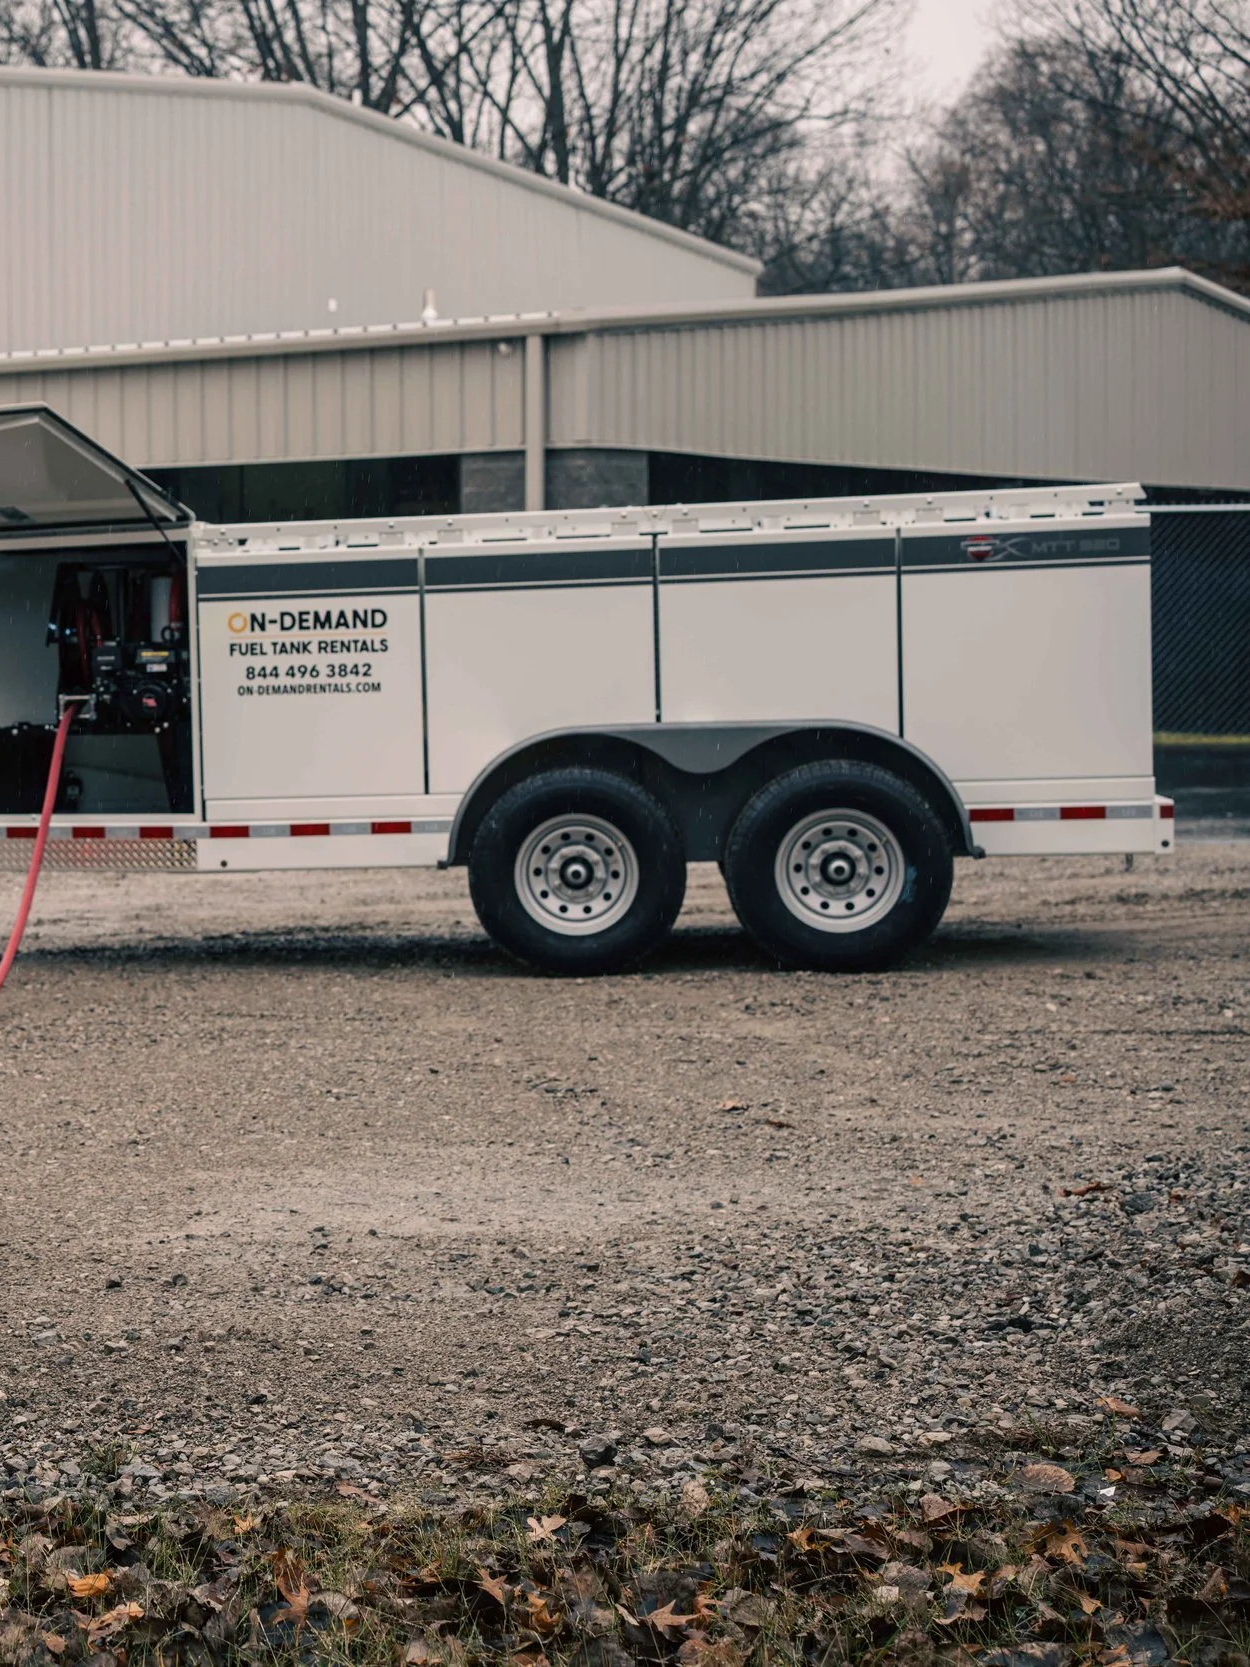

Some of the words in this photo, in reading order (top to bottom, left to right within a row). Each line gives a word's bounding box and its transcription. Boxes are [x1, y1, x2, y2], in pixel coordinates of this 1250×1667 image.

[1031, 540, 1076, 554] MTT
[227, 608, 388, 634] ON-DEMAND
[229, 642, 268, 657] FUEL
[271, 640, 313, 655] TANK
[318, 638, 389, 654] RENTALS
[245, 665, 280, 681] 844
[285, 663, 320, 679] 496
[325, 662, 372, 678] 3842
[237, 681, 381, 697] ON-DEMANDRENTALS.COM
